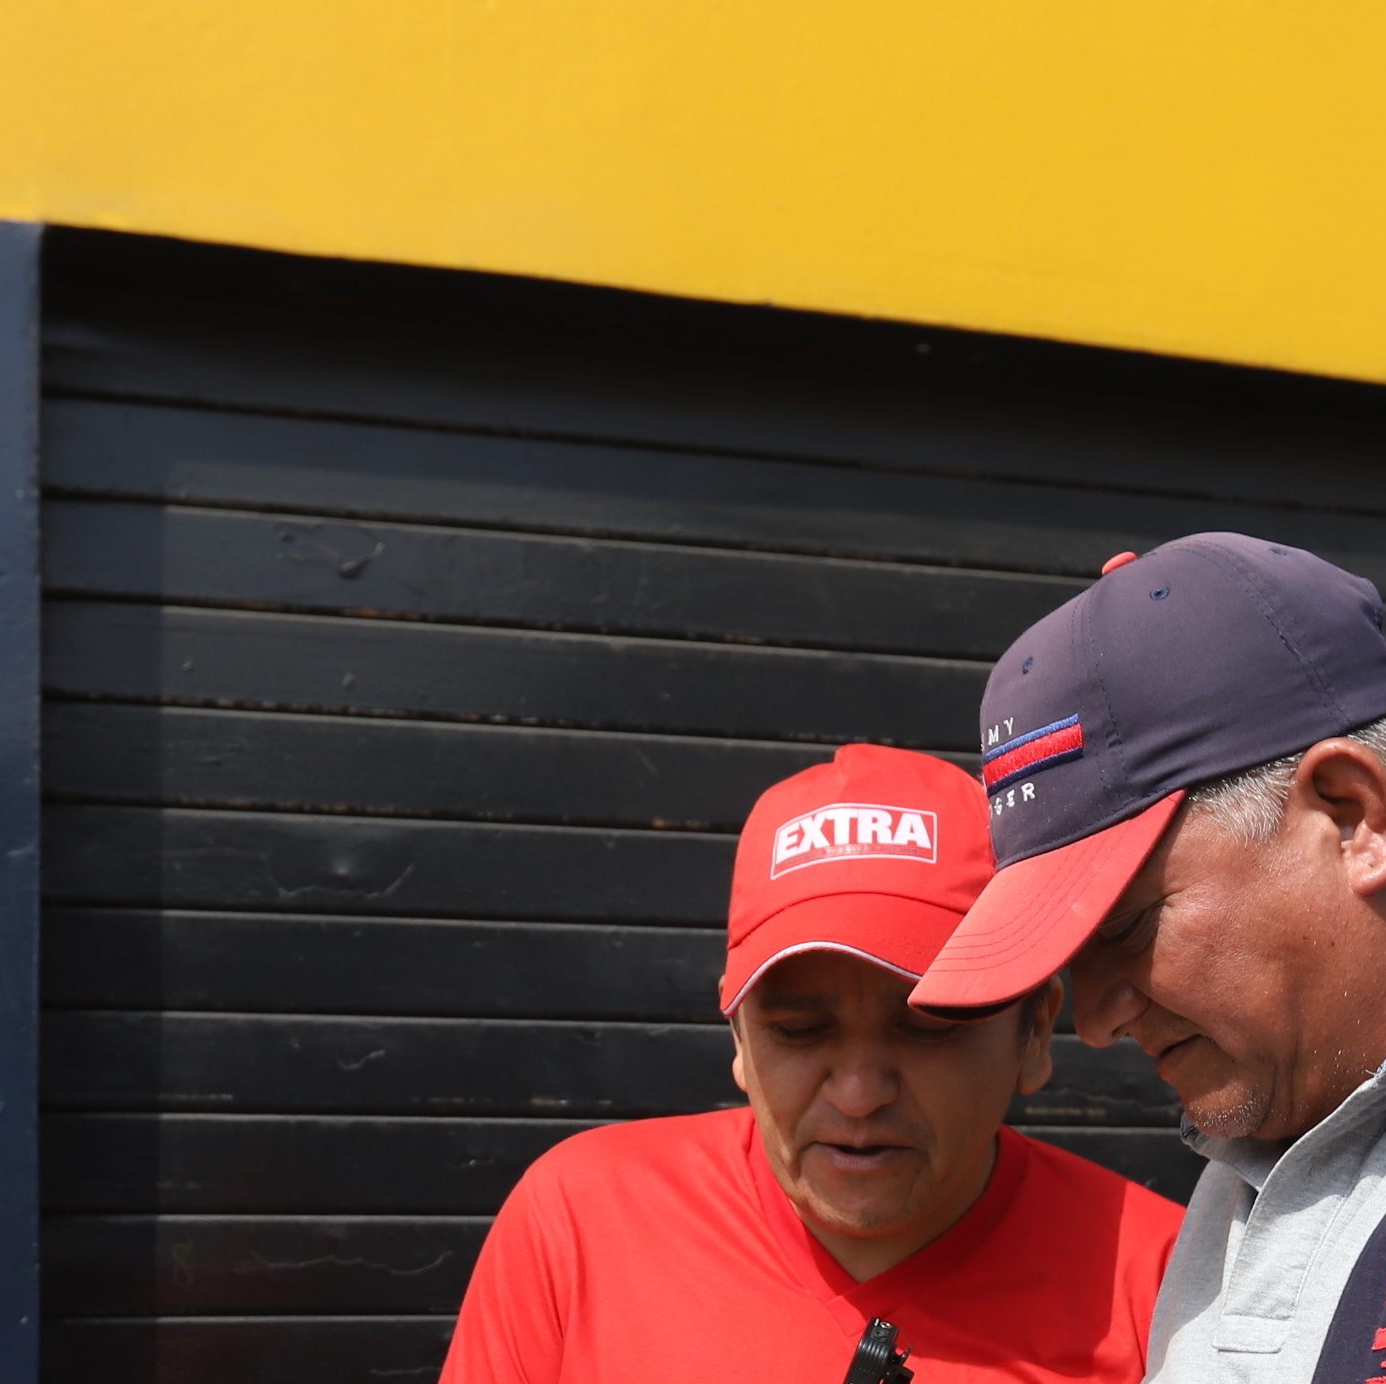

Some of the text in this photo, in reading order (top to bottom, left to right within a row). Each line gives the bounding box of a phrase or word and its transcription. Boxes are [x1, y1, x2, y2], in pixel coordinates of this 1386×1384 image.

[981, 716, 1014, 750] MY
[989, 782, 1035, 820] GER
[776, 808, 932, 865] EXTRA
